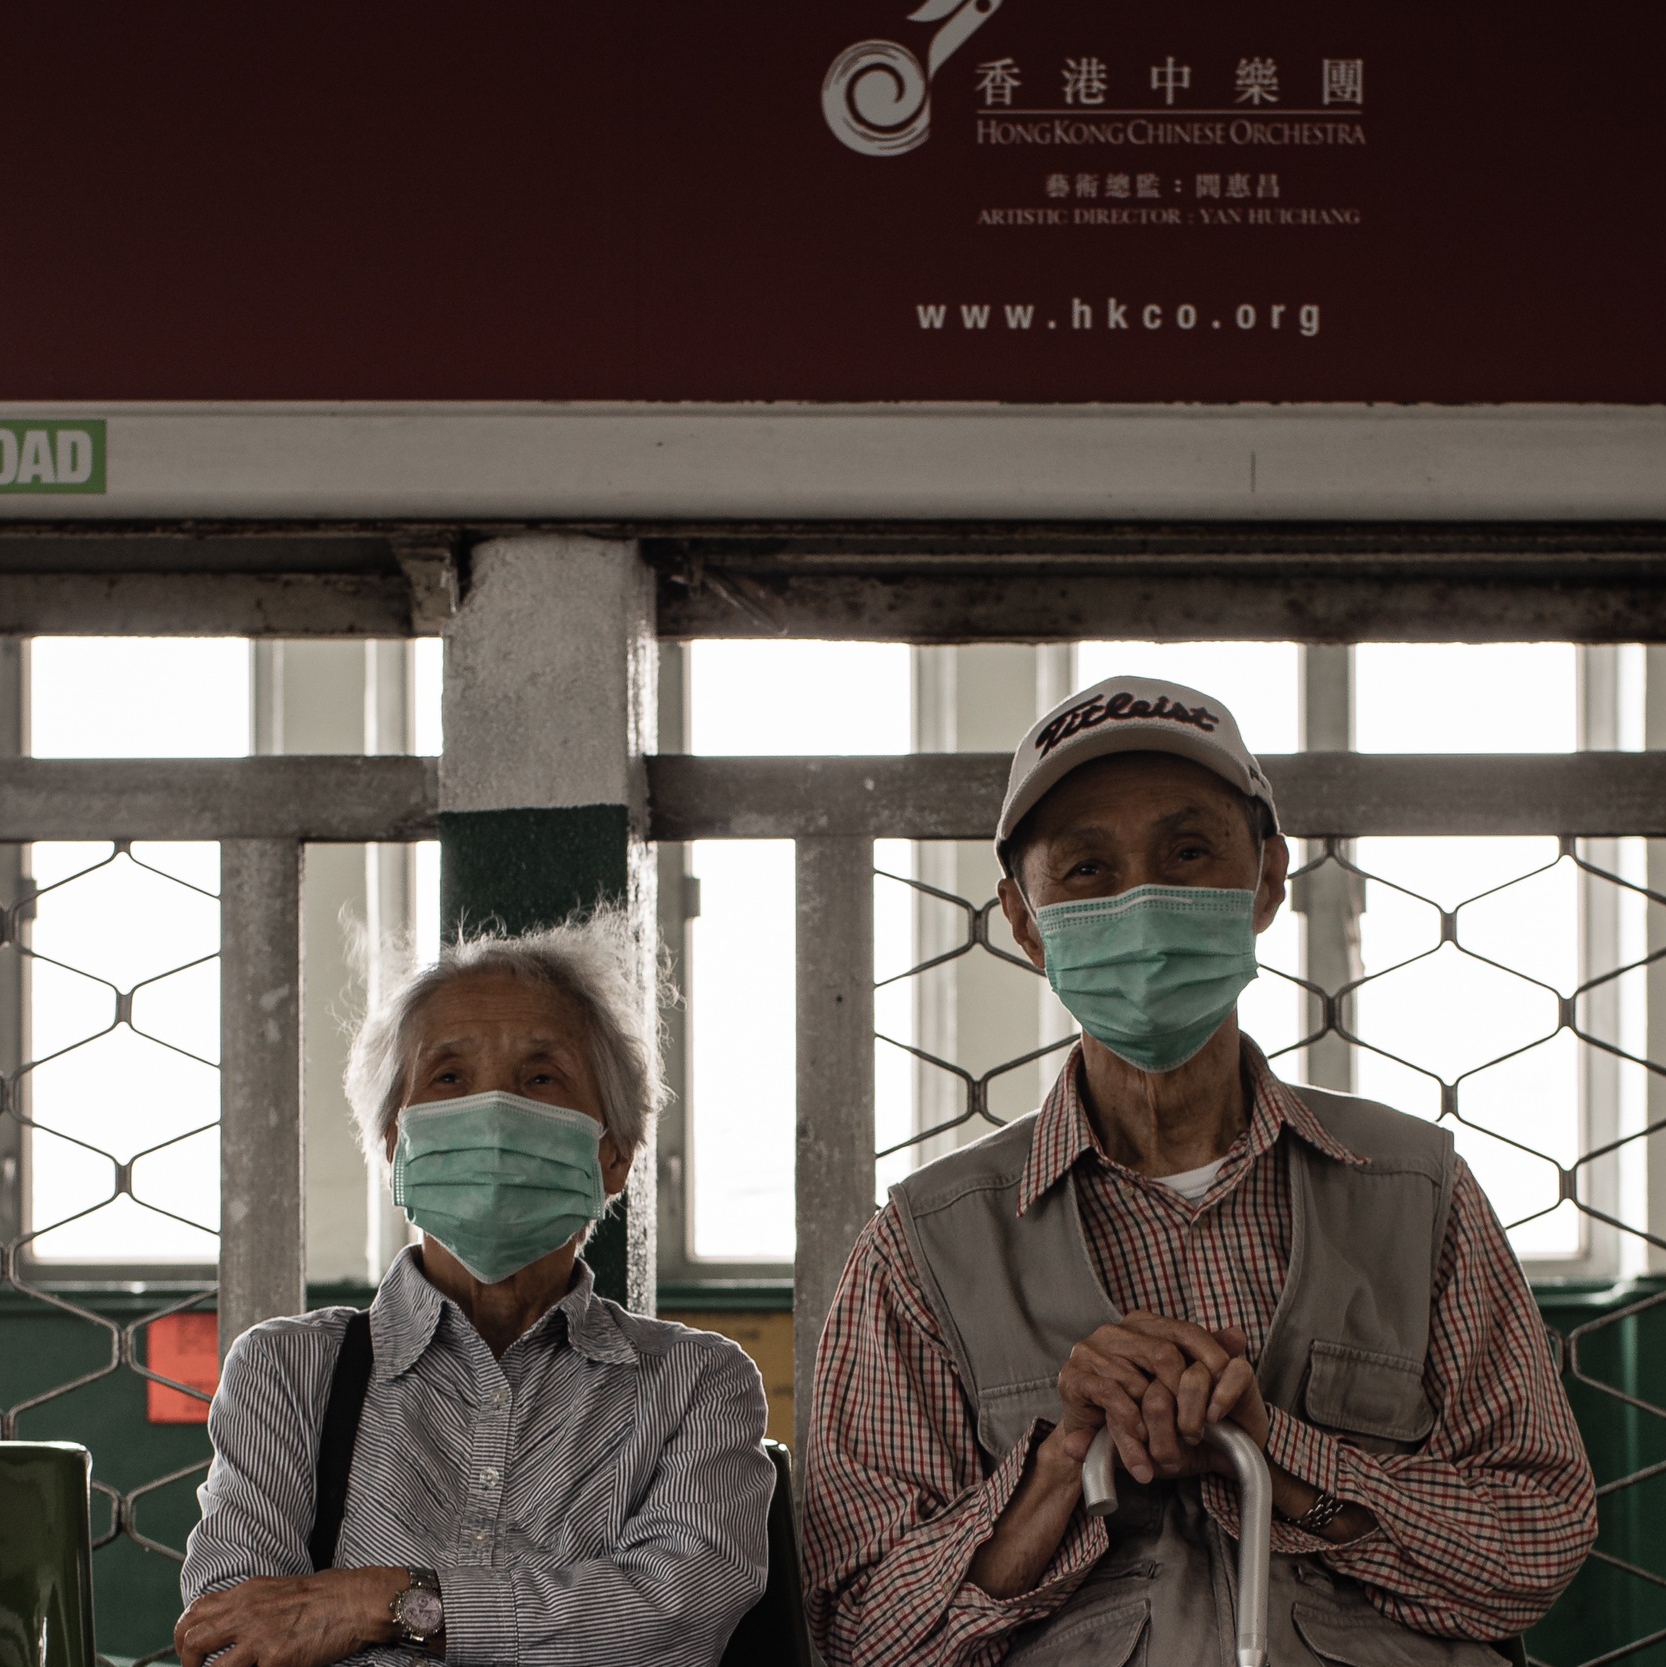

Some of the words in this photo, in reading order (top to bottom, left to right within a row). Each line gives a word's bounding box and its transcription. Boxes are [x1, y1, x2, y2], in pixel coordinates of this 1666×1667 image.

[976, 56, 1364, 105] 香港中樂團
[977, 208, 1069, 225] ARTISTIC
[1074, 208, 1181, 225] DIRECTOR
[916, 297, 1321, 338] www.hkco.org
